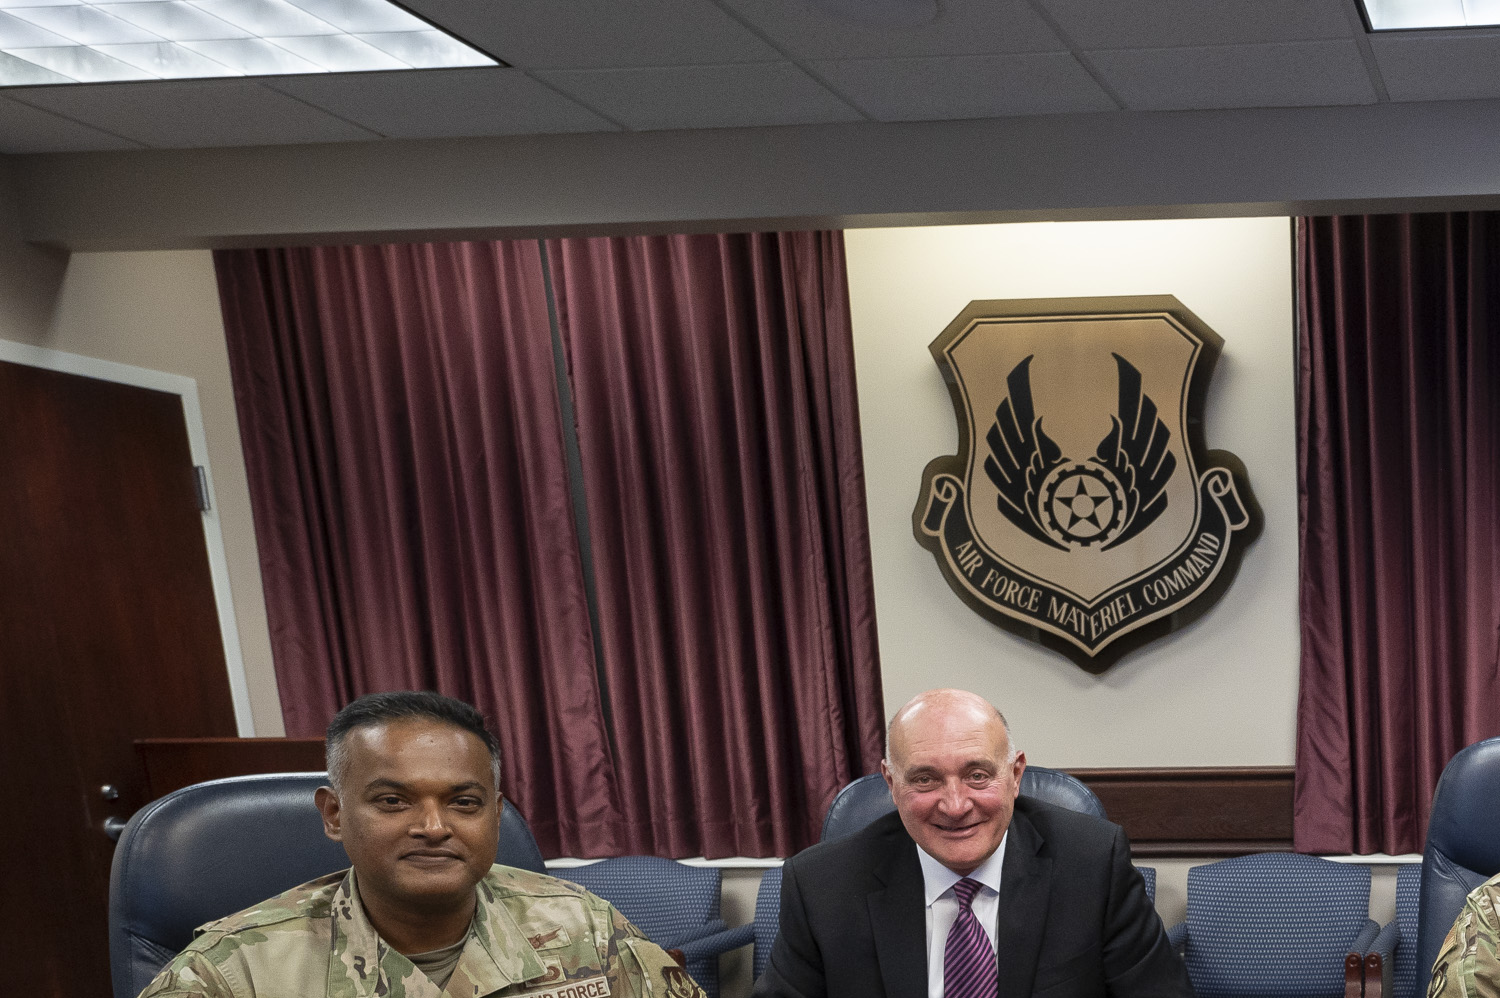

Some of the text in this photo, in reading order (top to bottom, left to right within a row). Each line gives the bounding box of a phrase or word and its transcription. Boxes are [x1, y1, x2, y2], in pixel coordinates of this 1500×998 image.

[955, 532, 1221, 641] AIR FORCE MATERIEL COMMAND
